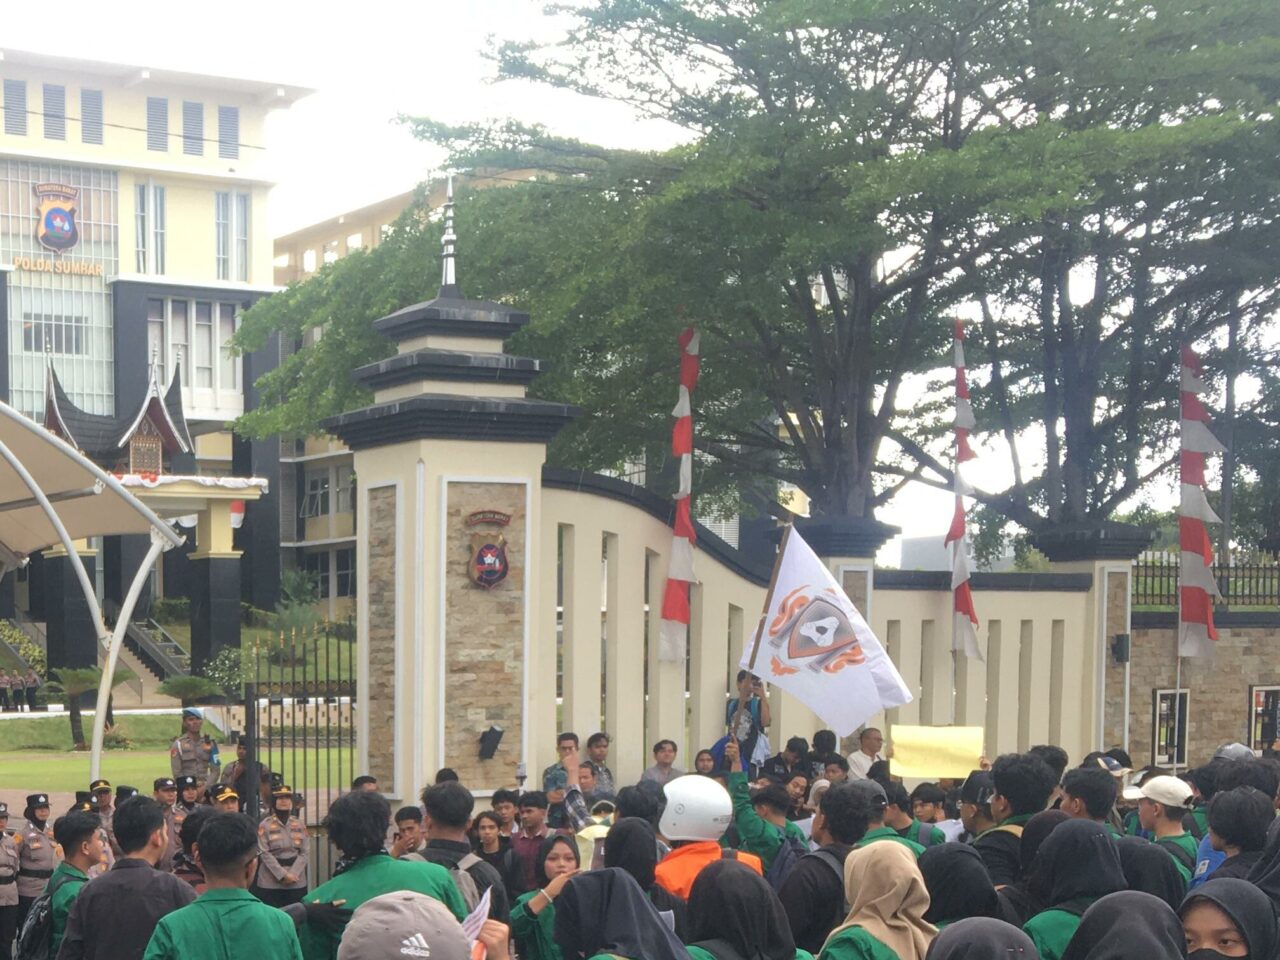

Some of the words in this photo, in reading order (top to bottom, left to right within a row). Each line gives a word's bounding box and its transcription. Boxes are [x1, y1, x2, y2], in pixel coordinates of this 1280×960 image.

[14, 256, 52, 272] POLDA
[54, 259, 103, 276] SUMBAR
[400, 946, 431, 958] adidas
